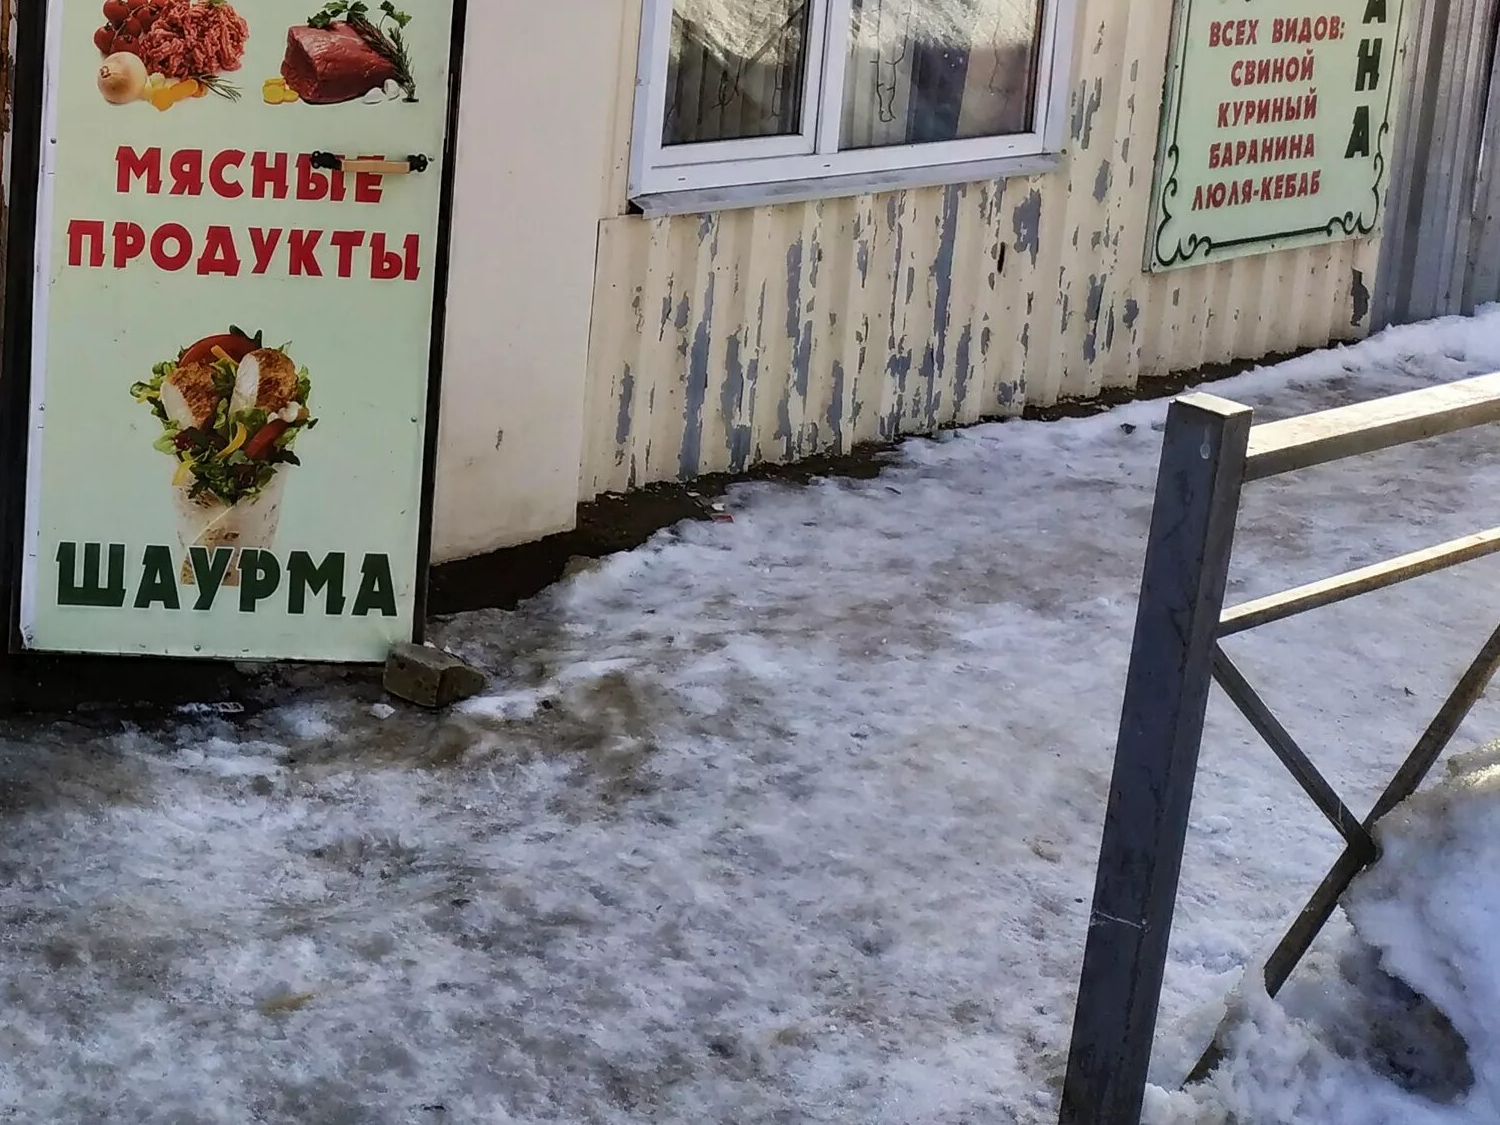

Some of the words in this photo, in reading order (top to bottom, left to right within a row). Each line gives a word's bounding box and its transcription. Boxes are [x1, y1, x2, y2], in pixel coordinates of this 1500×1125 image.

[1208, 19, 1259, 47] ВСЕХ
[1271, 15, 1345, 43] ВИДОВ:
[1230, 48, 1315, 87] СВИНОЙ
[1217, 87, 1318, 128] КУРИНЫЙ
[1208, 134, 1315, 169] БАРАНИНА
[115, 145, 386, 204] МЯСНЫЕ
[1191, 170, 1321, 211] ЛЮЛЯ-КЕБАБ
[66, 219, 421, 281] ПРОДУКТЫ
[55, 541, 398, 617] ШАУРМА
